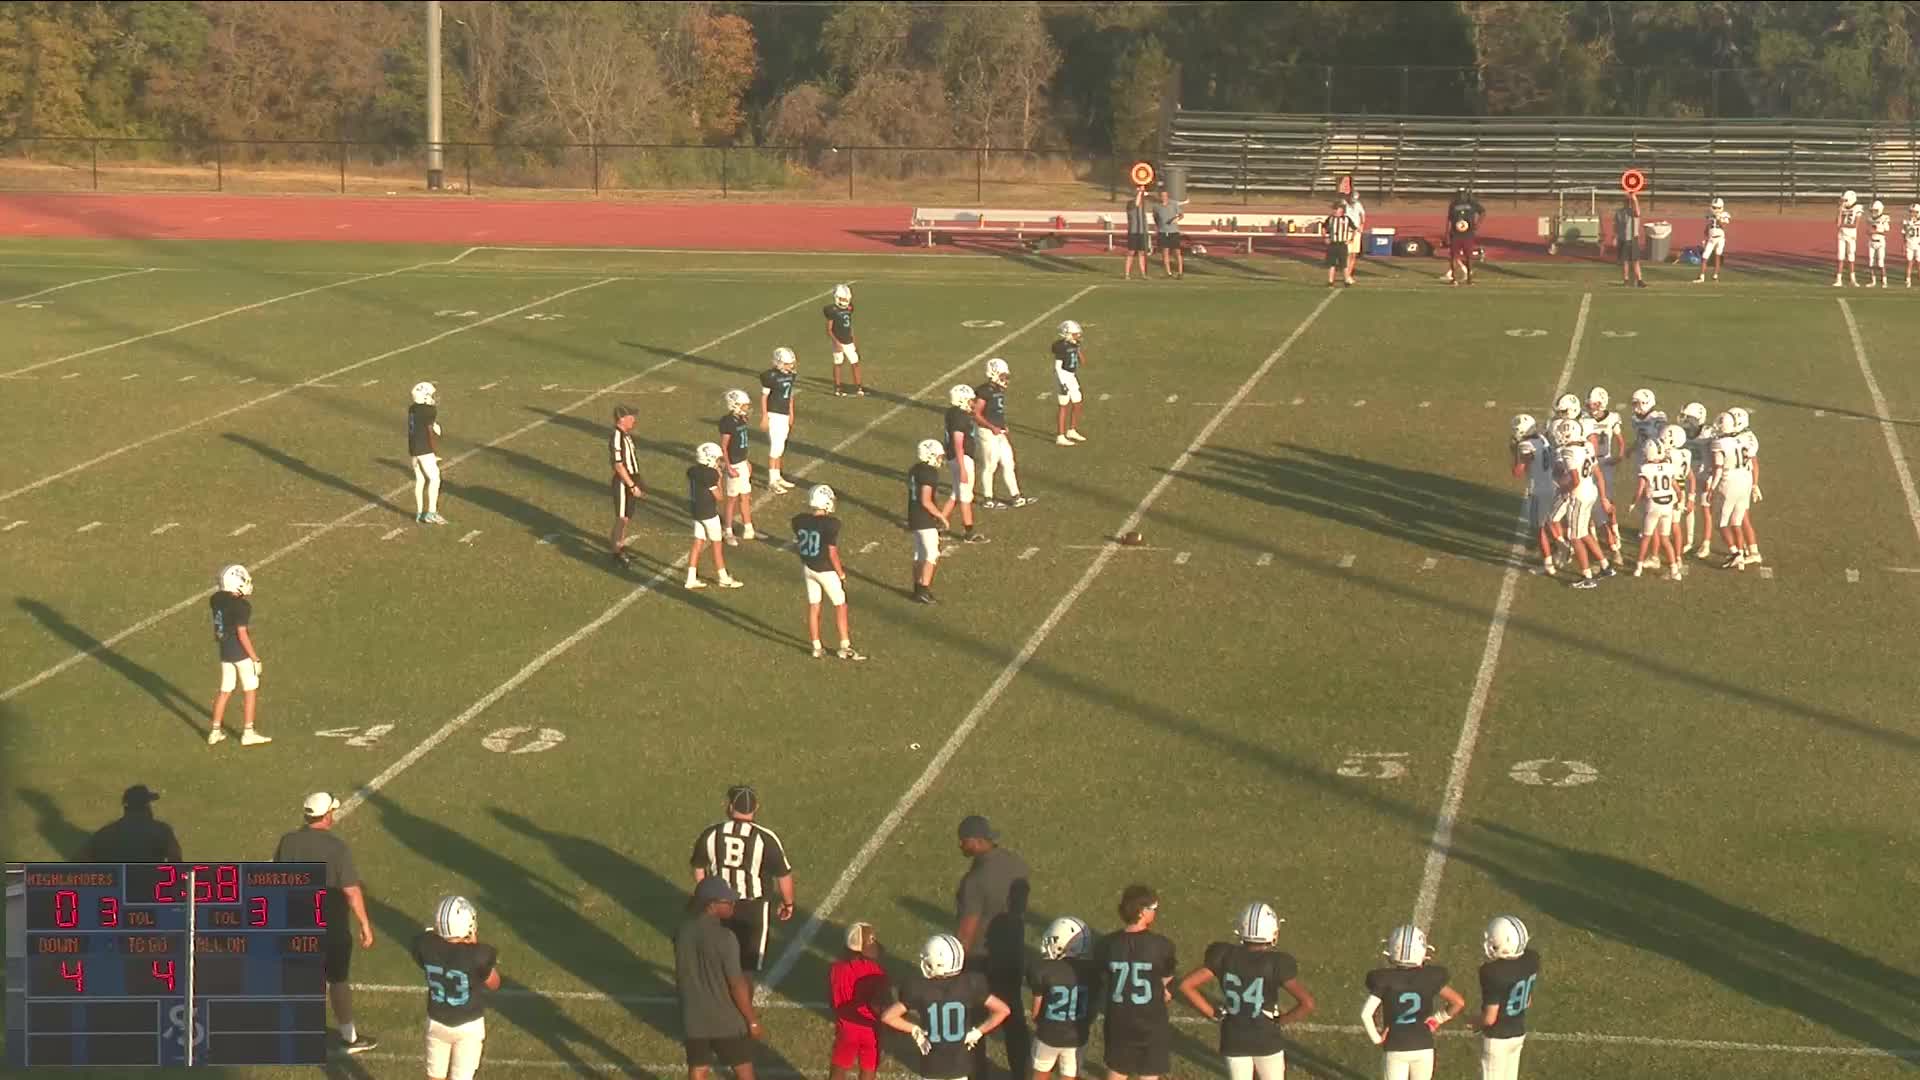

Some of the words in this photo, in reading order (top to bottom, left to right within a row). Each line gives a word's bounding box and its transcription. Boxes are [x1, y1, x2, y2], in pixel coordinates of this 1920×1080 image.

[1652, 474, 1670, 492] 10
[723, 835, 745, 868] B
[424, 963, 470, 1007] 53
[1108, 960, 1154, 1005] 75
[926, 1000, 966, 1044] 10
[1395, 991, 1422, 1025] 2
